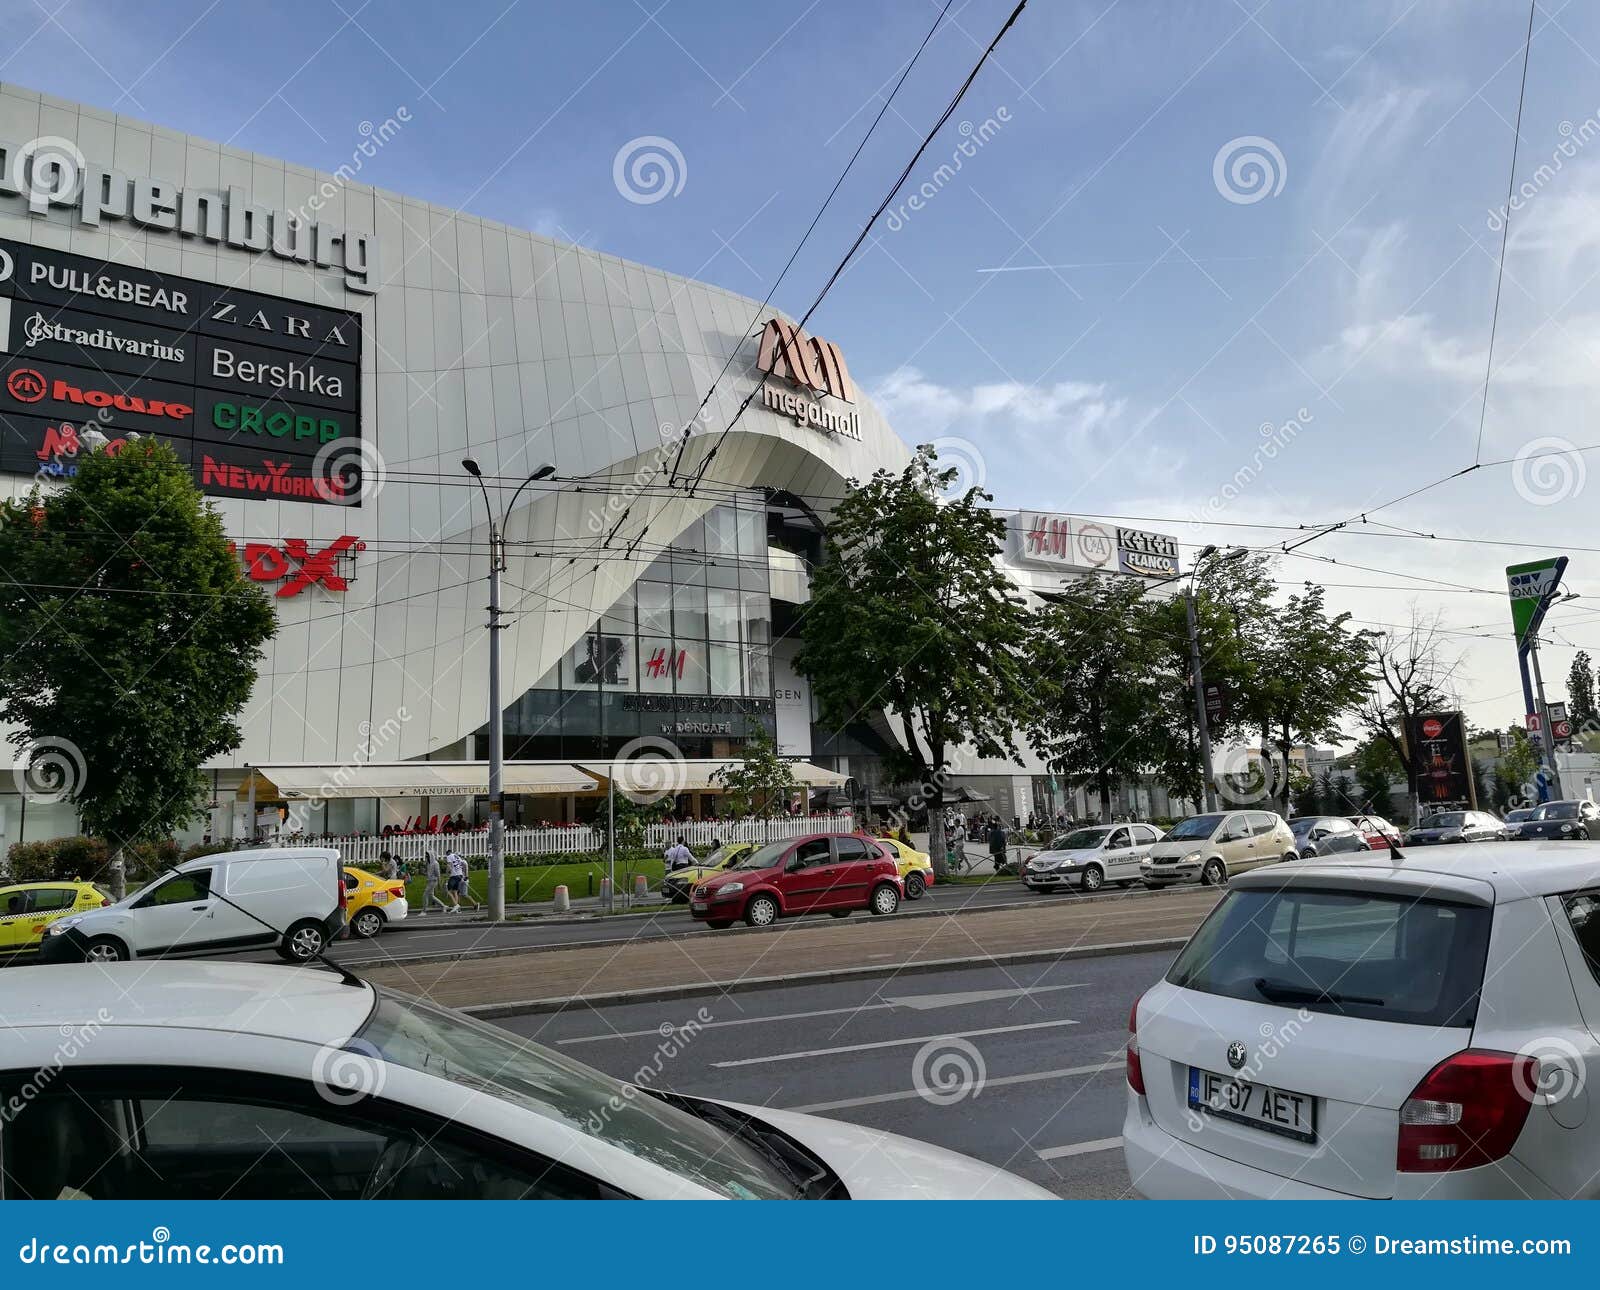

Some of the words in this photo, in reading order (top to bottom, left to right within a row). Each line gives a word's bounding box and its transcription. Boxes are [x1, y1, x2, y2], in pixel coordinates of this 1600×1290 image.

[30, 261, 188, 314] PULL&BEAR
[212, 300, 349, 346] ZARA
[212, 348, 343, 398] Bershka
[53, 380, 193, 419] house
[213, 402, 341, 443] CROPP
[763, 384, 863, 441] megamall
[225, 535, 361, 597] DX
[1128, 552, 1171, 571] FLANCO
[1511, 584, 1542, 598] OMV
[646, 647, 686, 681] H&M
[1229, 1081, 1253, 1112] 07
[1261, 1089, 1304, 1127] AET
